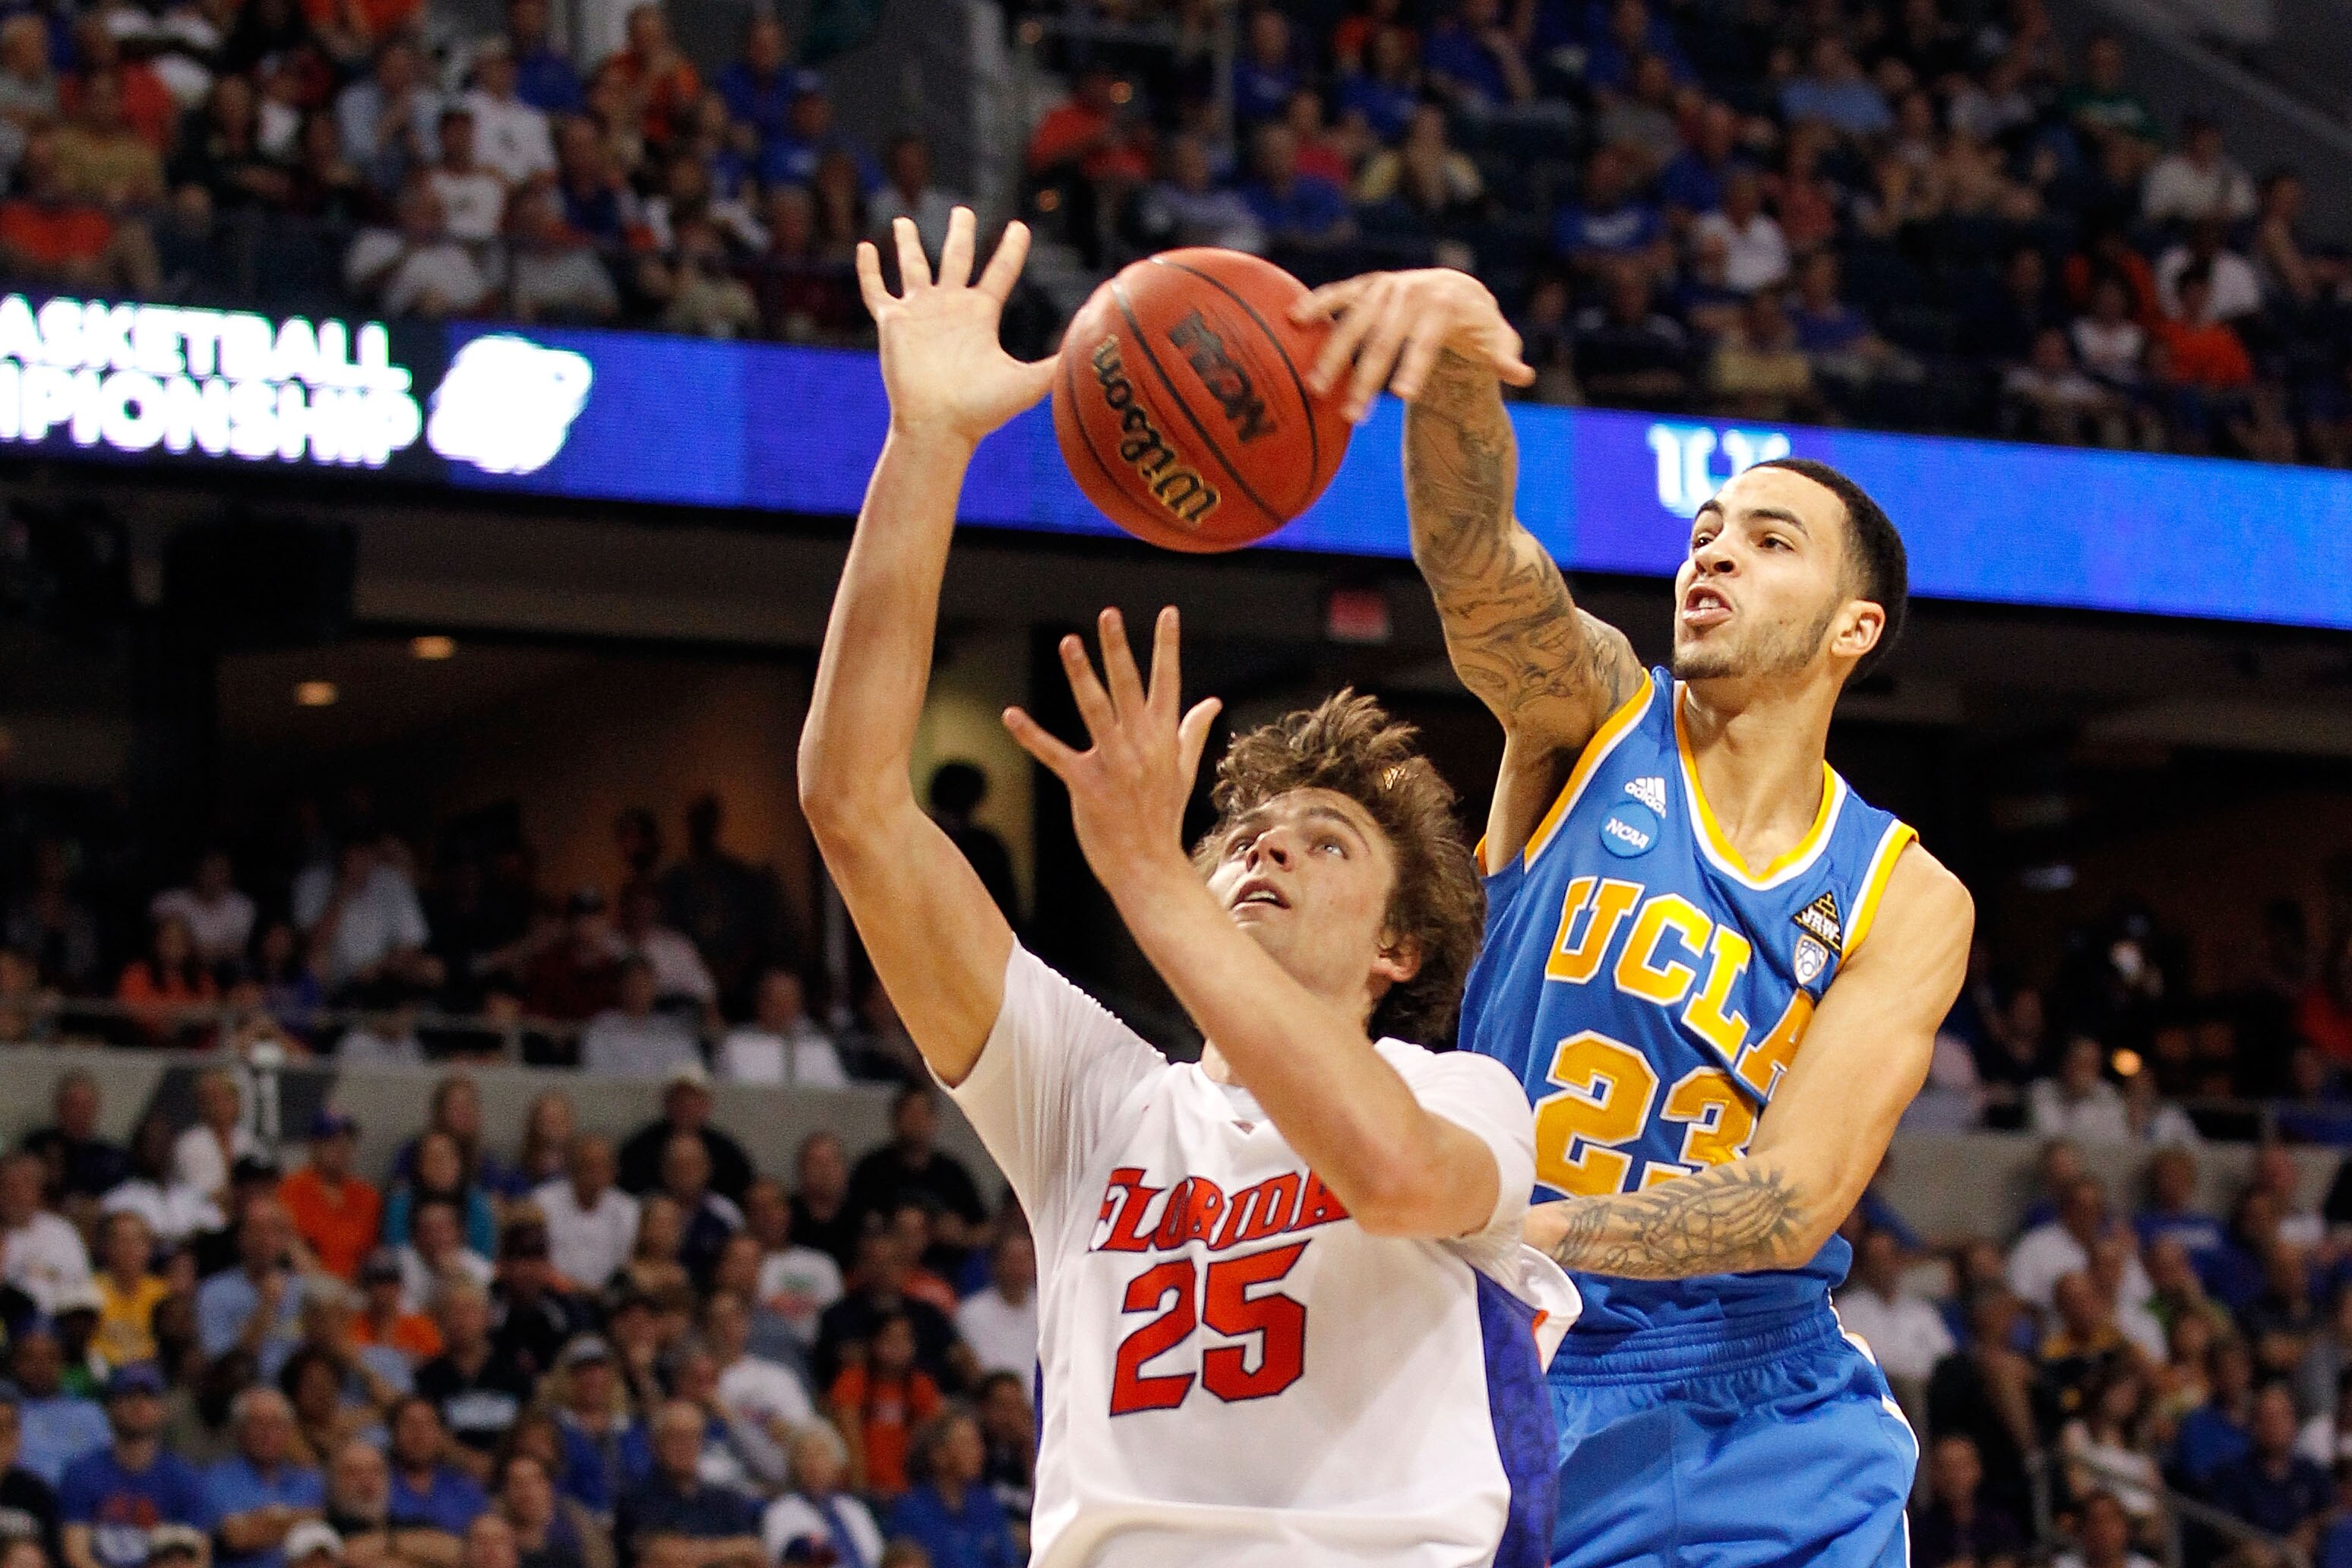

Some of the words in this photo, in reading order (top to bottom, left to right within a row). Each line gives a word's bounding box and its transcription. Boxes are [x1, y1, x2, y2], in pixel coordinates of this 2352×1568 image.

[1093, 334, 1221, 524] Wilson
[1605, 817, 1650, 849] NCAA
[1624, 782, 1667, 819] adidas
[1109, 1238, 1311, 1418] 25
